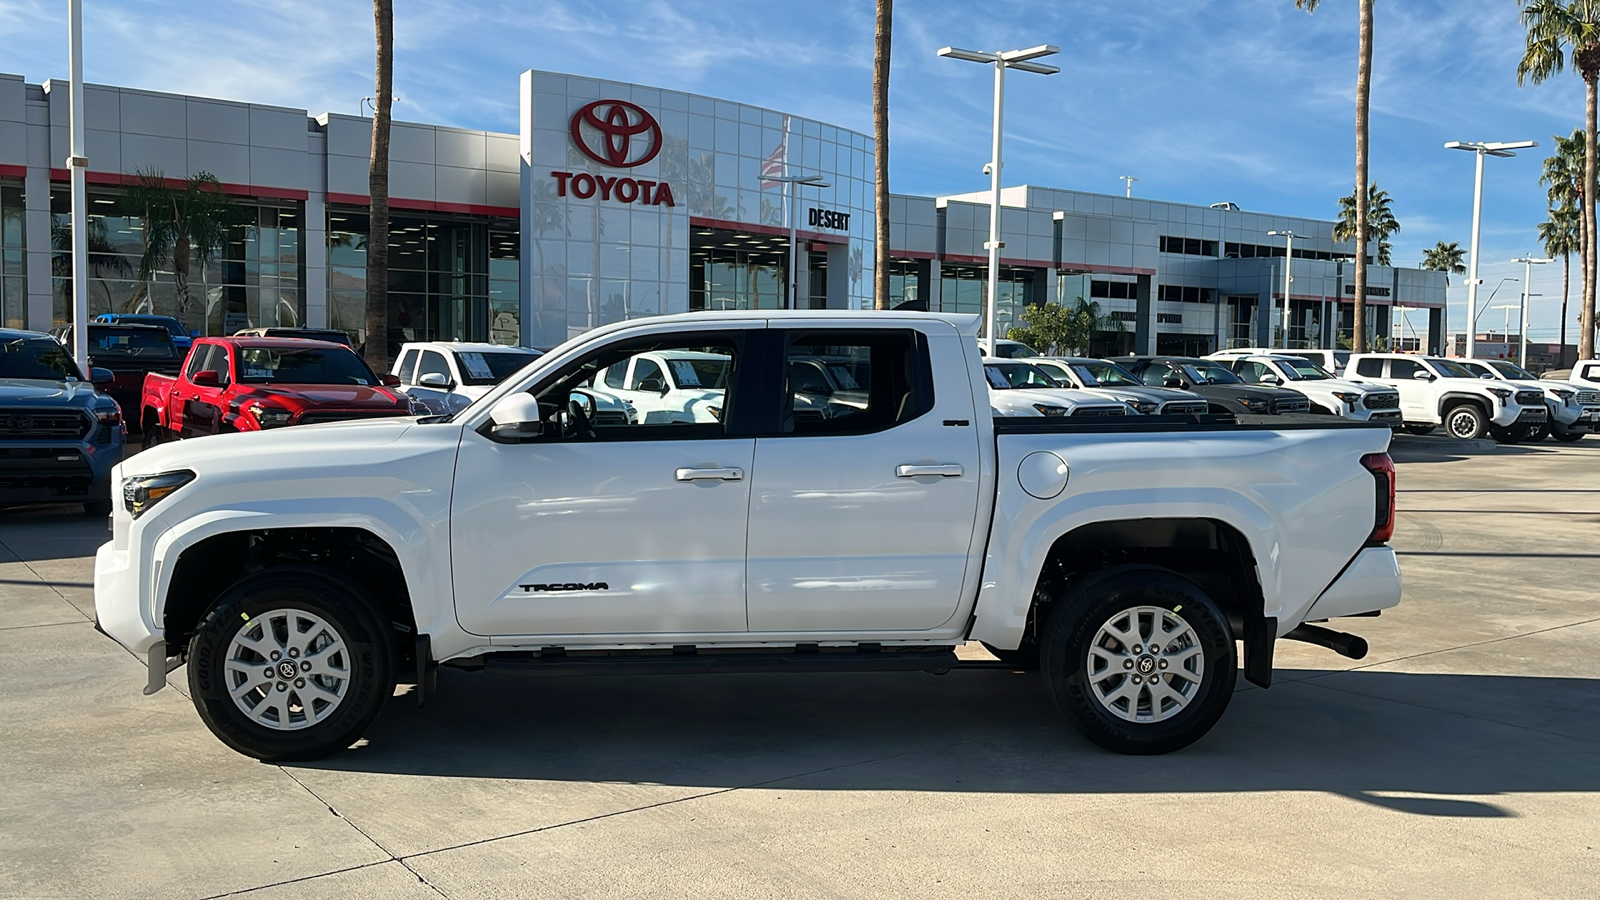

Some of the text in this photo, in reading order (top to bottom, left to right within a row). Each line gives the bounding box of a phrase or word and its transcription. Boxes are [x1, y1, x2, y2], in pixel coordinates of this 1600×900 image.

[551, 171, 675, 207] TOYOTA
[809, 208, 850, 231] DESERT
[519, 582, 608, 592] TACOMA
[198, 600, 242, 691] GOODYEAR
[331, 649, 374, 733] WRANGLE
